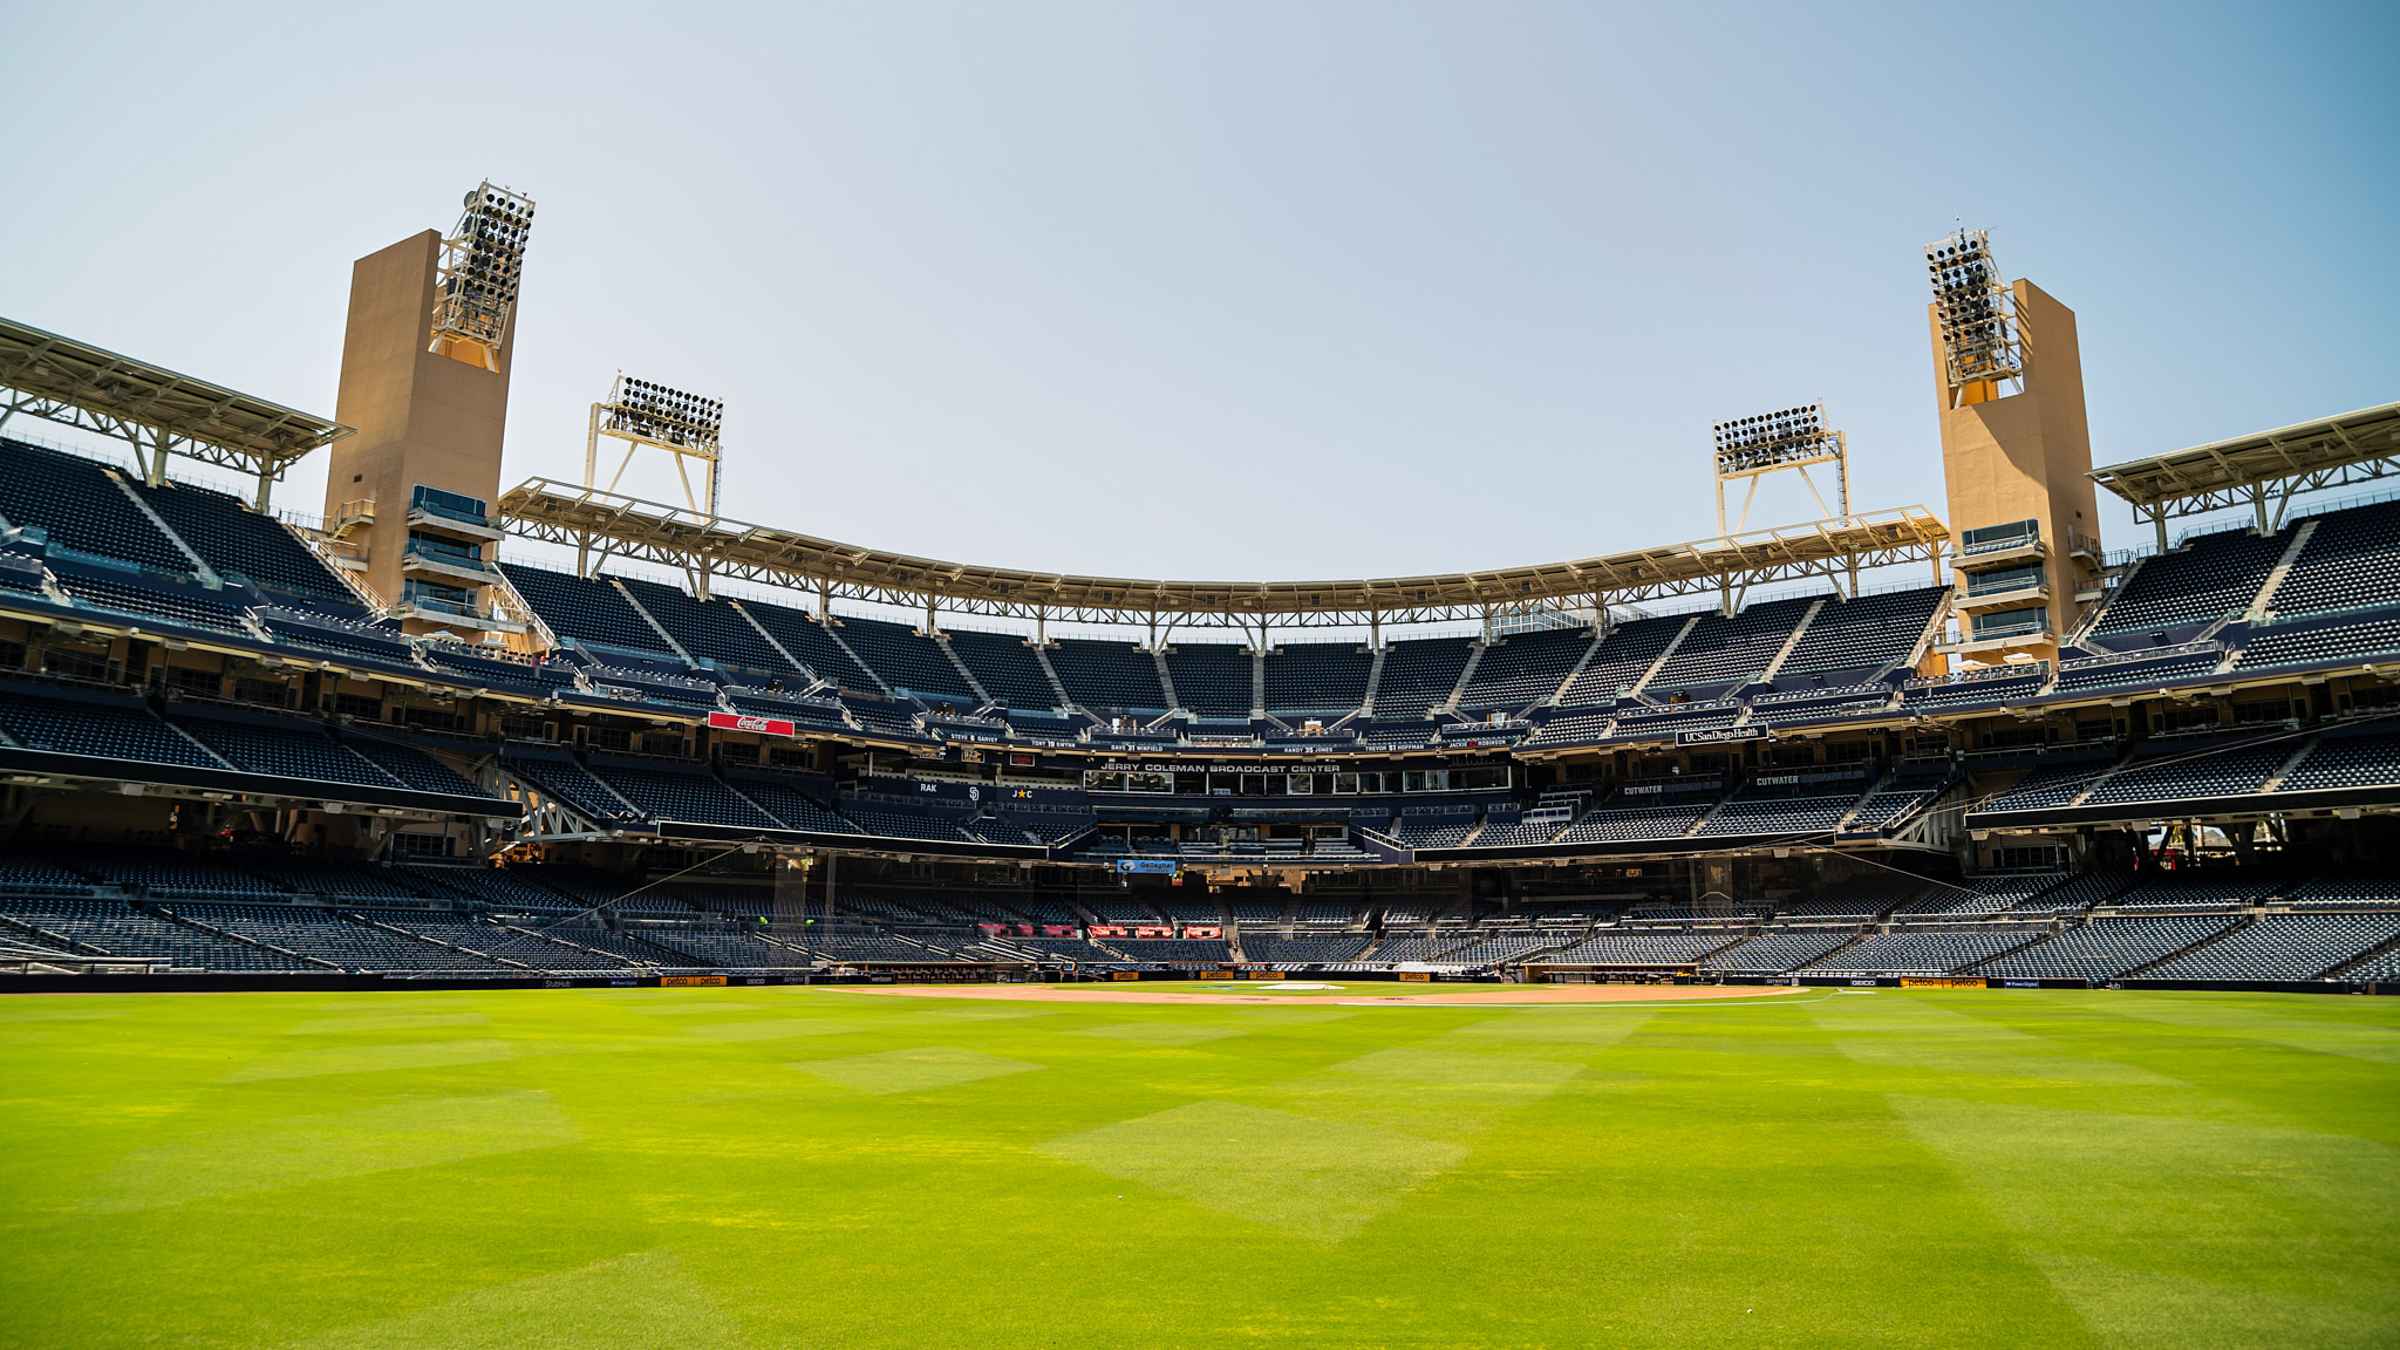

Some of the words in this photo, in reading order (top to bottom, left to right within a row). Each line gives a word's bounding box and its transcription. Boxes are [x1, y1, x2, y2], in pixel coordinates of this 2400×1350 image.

[1684, 732, 1698, 742] UC
[1698, 731, 1712, 741] San
[1712, 730, 1734, 741] Diego
[1733, 727, 1759, 738] Health
[1101, 762, 1140, 772] JERRY
[1145, 763, 1205, 773] COLEMAN
[1210, 765, 1286, 774] BROADCAST
[1291, 765, 1341, 774] CENTER
[1757, 775, 1799, 786] CUTWATER
[920, 783, 937, 793] RAK
[1624, 785, 1663, 795] CUTWATER
[1908, 979, 1934, 989] petco
[1951, 979, 1978, 989] petco
